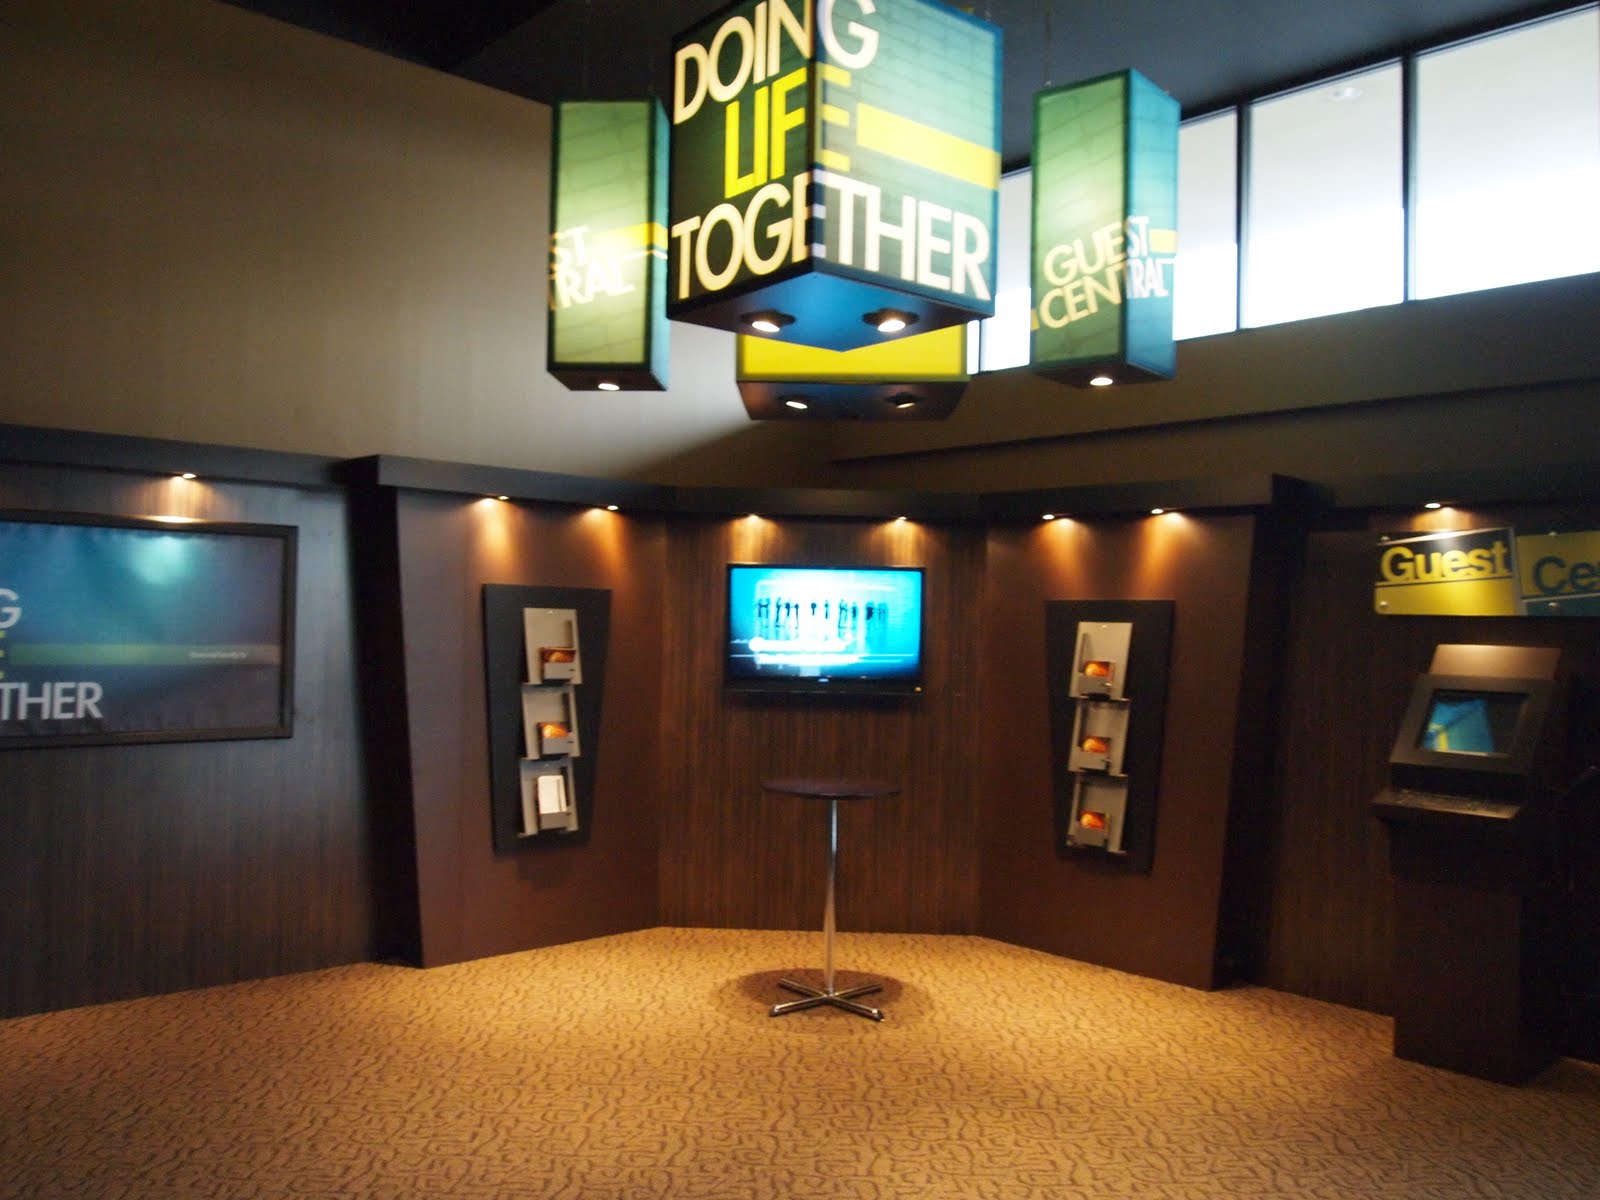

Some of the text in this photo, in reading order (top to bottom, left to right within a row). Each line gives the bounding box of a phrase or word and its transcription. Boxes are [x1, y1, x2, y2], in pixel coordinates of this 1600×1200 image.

[673, 0, 880, 125] DOING
[724, 61, 851, 199] LIFE
[671, 168, 992, 301] TOGETHER
[1043, 215, 1150, 286] GUEST
[1039, 256, 1170, 329] CENTRAL
[1381, 539, 1600, 595] Guest Ce
